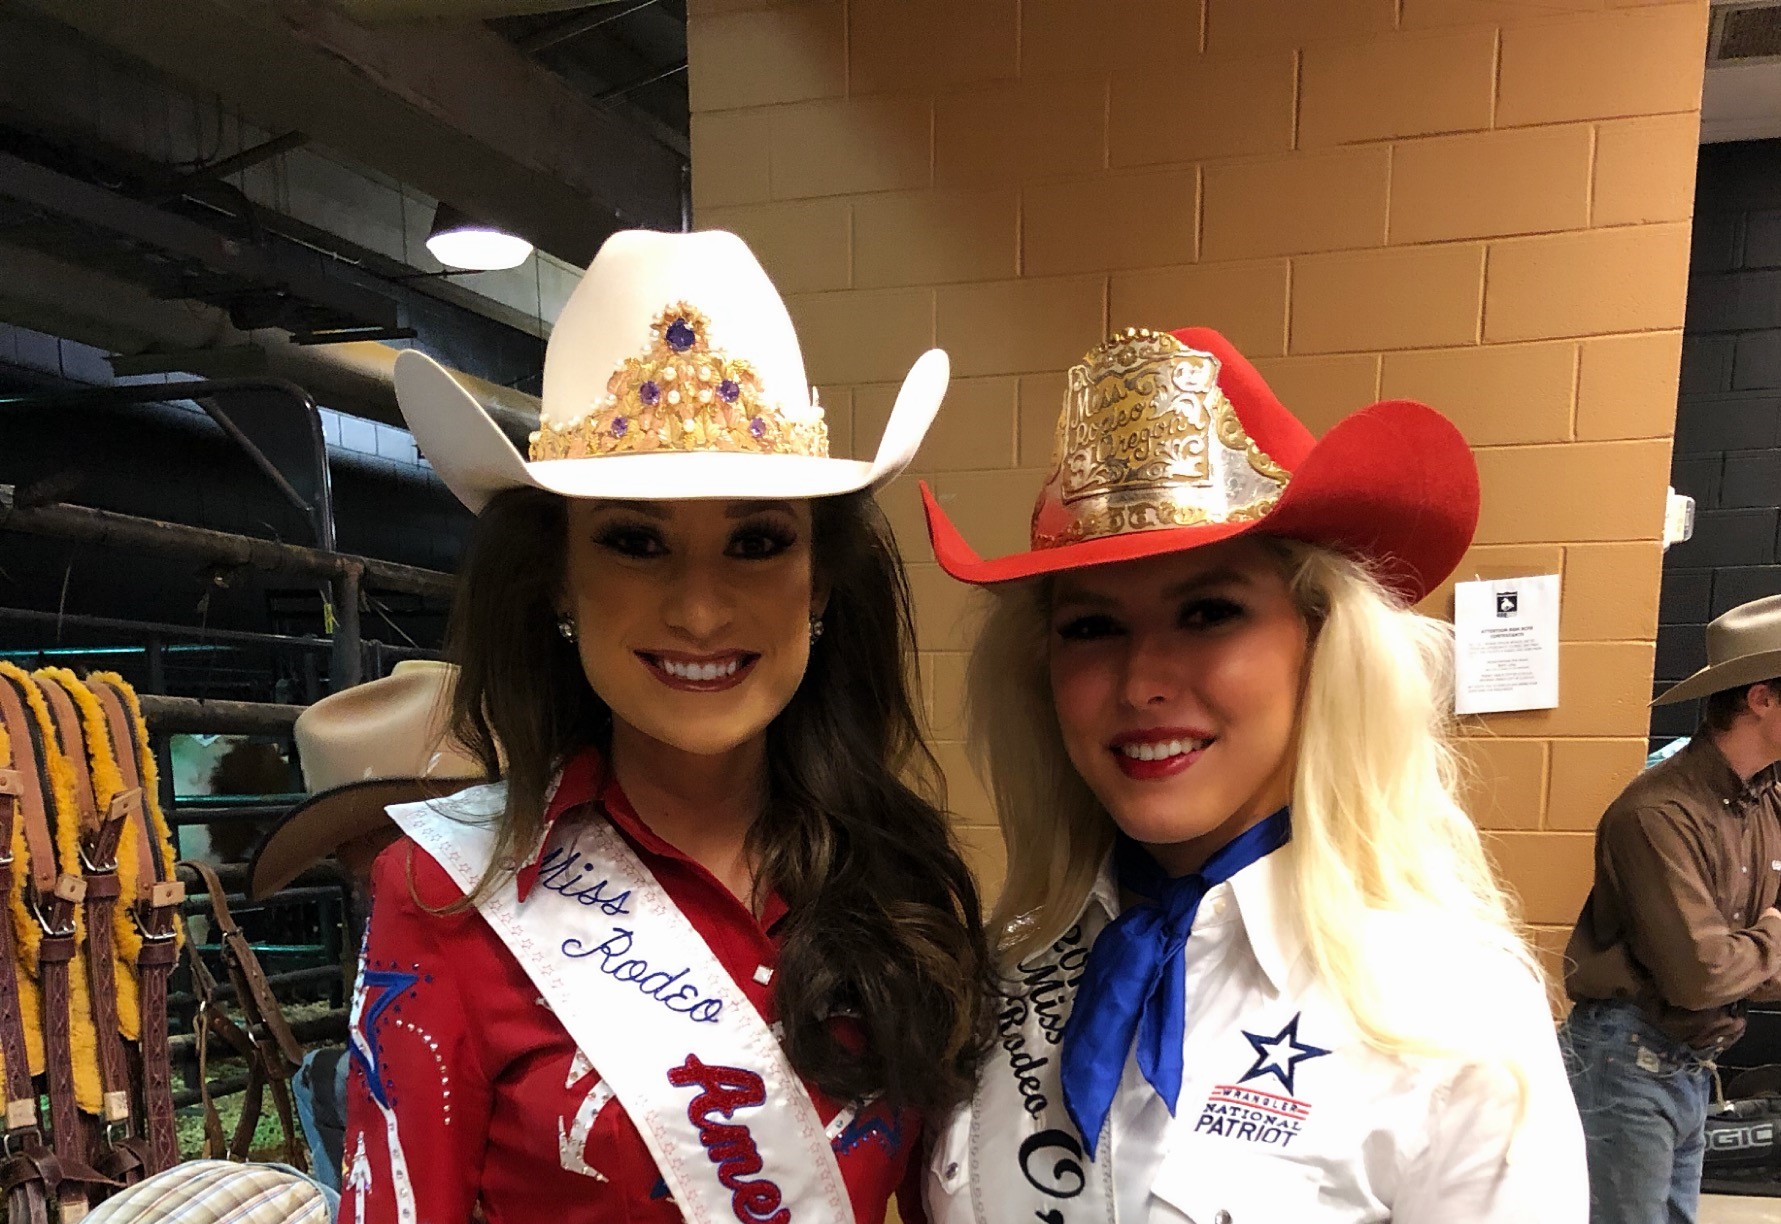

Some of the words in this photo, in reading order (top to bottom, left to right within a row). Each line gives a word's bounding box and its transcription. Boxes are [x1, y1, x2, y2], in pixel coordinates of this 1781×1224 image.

[561, 927, 723, 1023] Rodeo
[1016, 961, 1066, 1045] Miss
[1000, 996, 1049, 1120] Rodeo
[1202, 1103, 1303, 1132] NATIONAL
[1222, 1088, 1299, 1113] WRANGLER
[1193, 1113, 1298, 1148] PATRIOT
